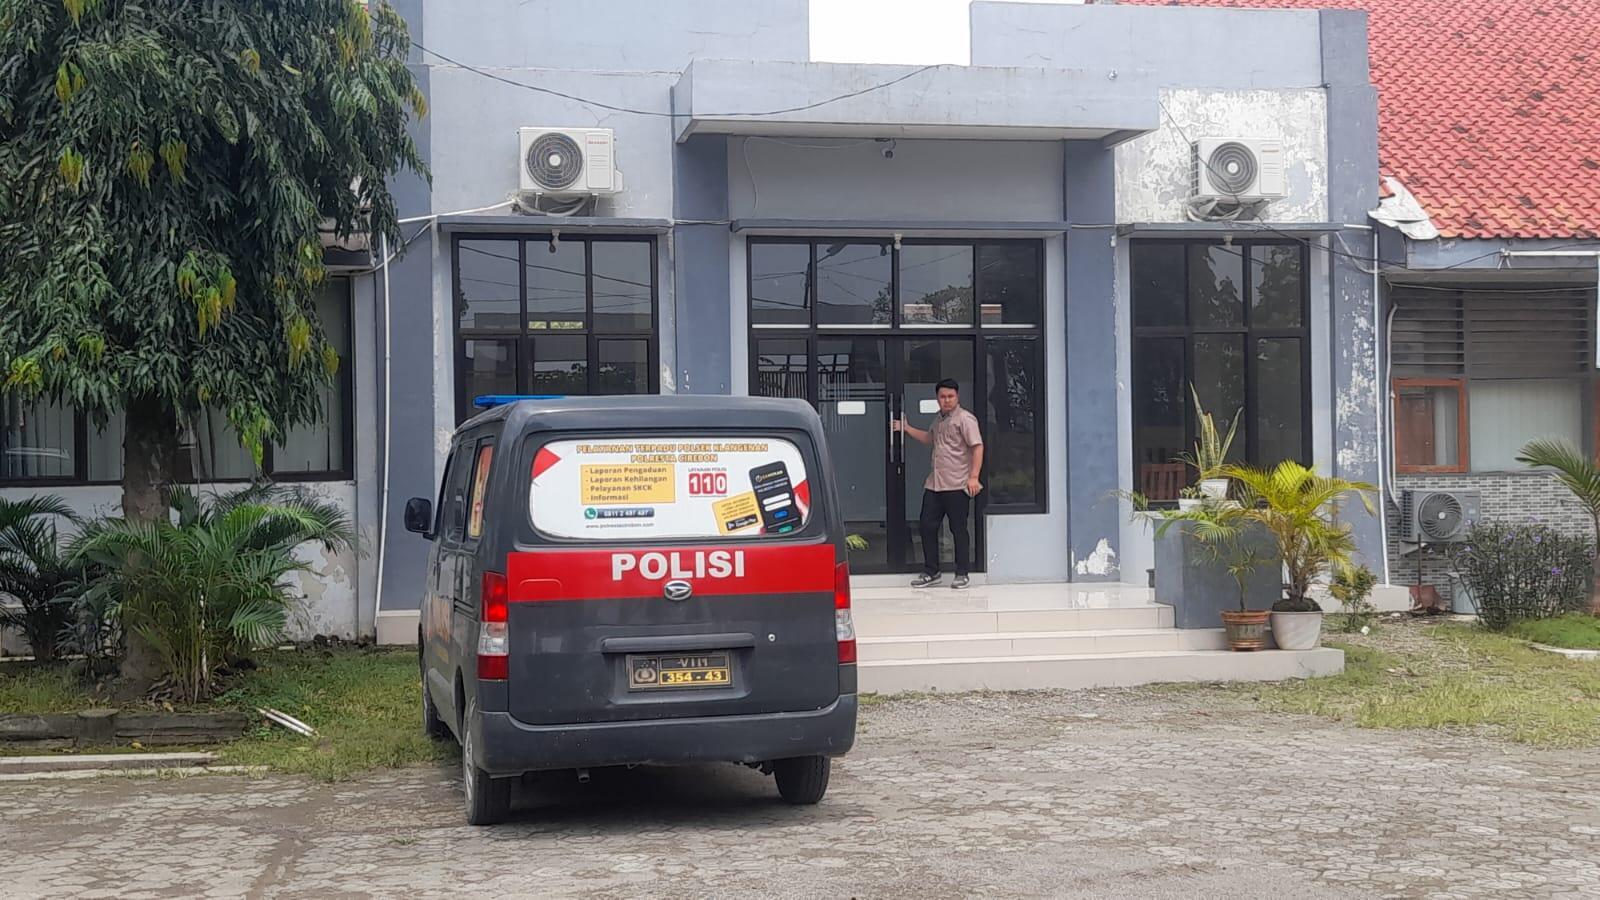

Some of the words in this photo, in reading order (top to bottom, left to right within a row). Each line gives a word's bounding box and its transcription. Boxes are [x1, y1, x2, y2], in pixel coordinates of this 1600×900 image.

[576, 444, 633, 454] PELAYANAN
[635, 444, 676, 453] TERPADU
[678, 443, 712, 453] POLSEK
[713, 443, 768, 452] KLANGENAN
[630, 454, 677, 463] POLRESTA
[678, 453, 718, 463] CIREBON
[590, 467, 622, 476] Laporan
[624, 466, 667, 476] Pengaduan
[590, 476, 622, 485] Laporan
[624, 475, 667, 483] Kehilangan
[690, 474, 727, 493] 110
[590, 485, 631, 493] Pelayanan
[612, 550, 745, 581] POLISI
[667, 672, 692, 682] 354
[705, 671, 722, 681] 43
